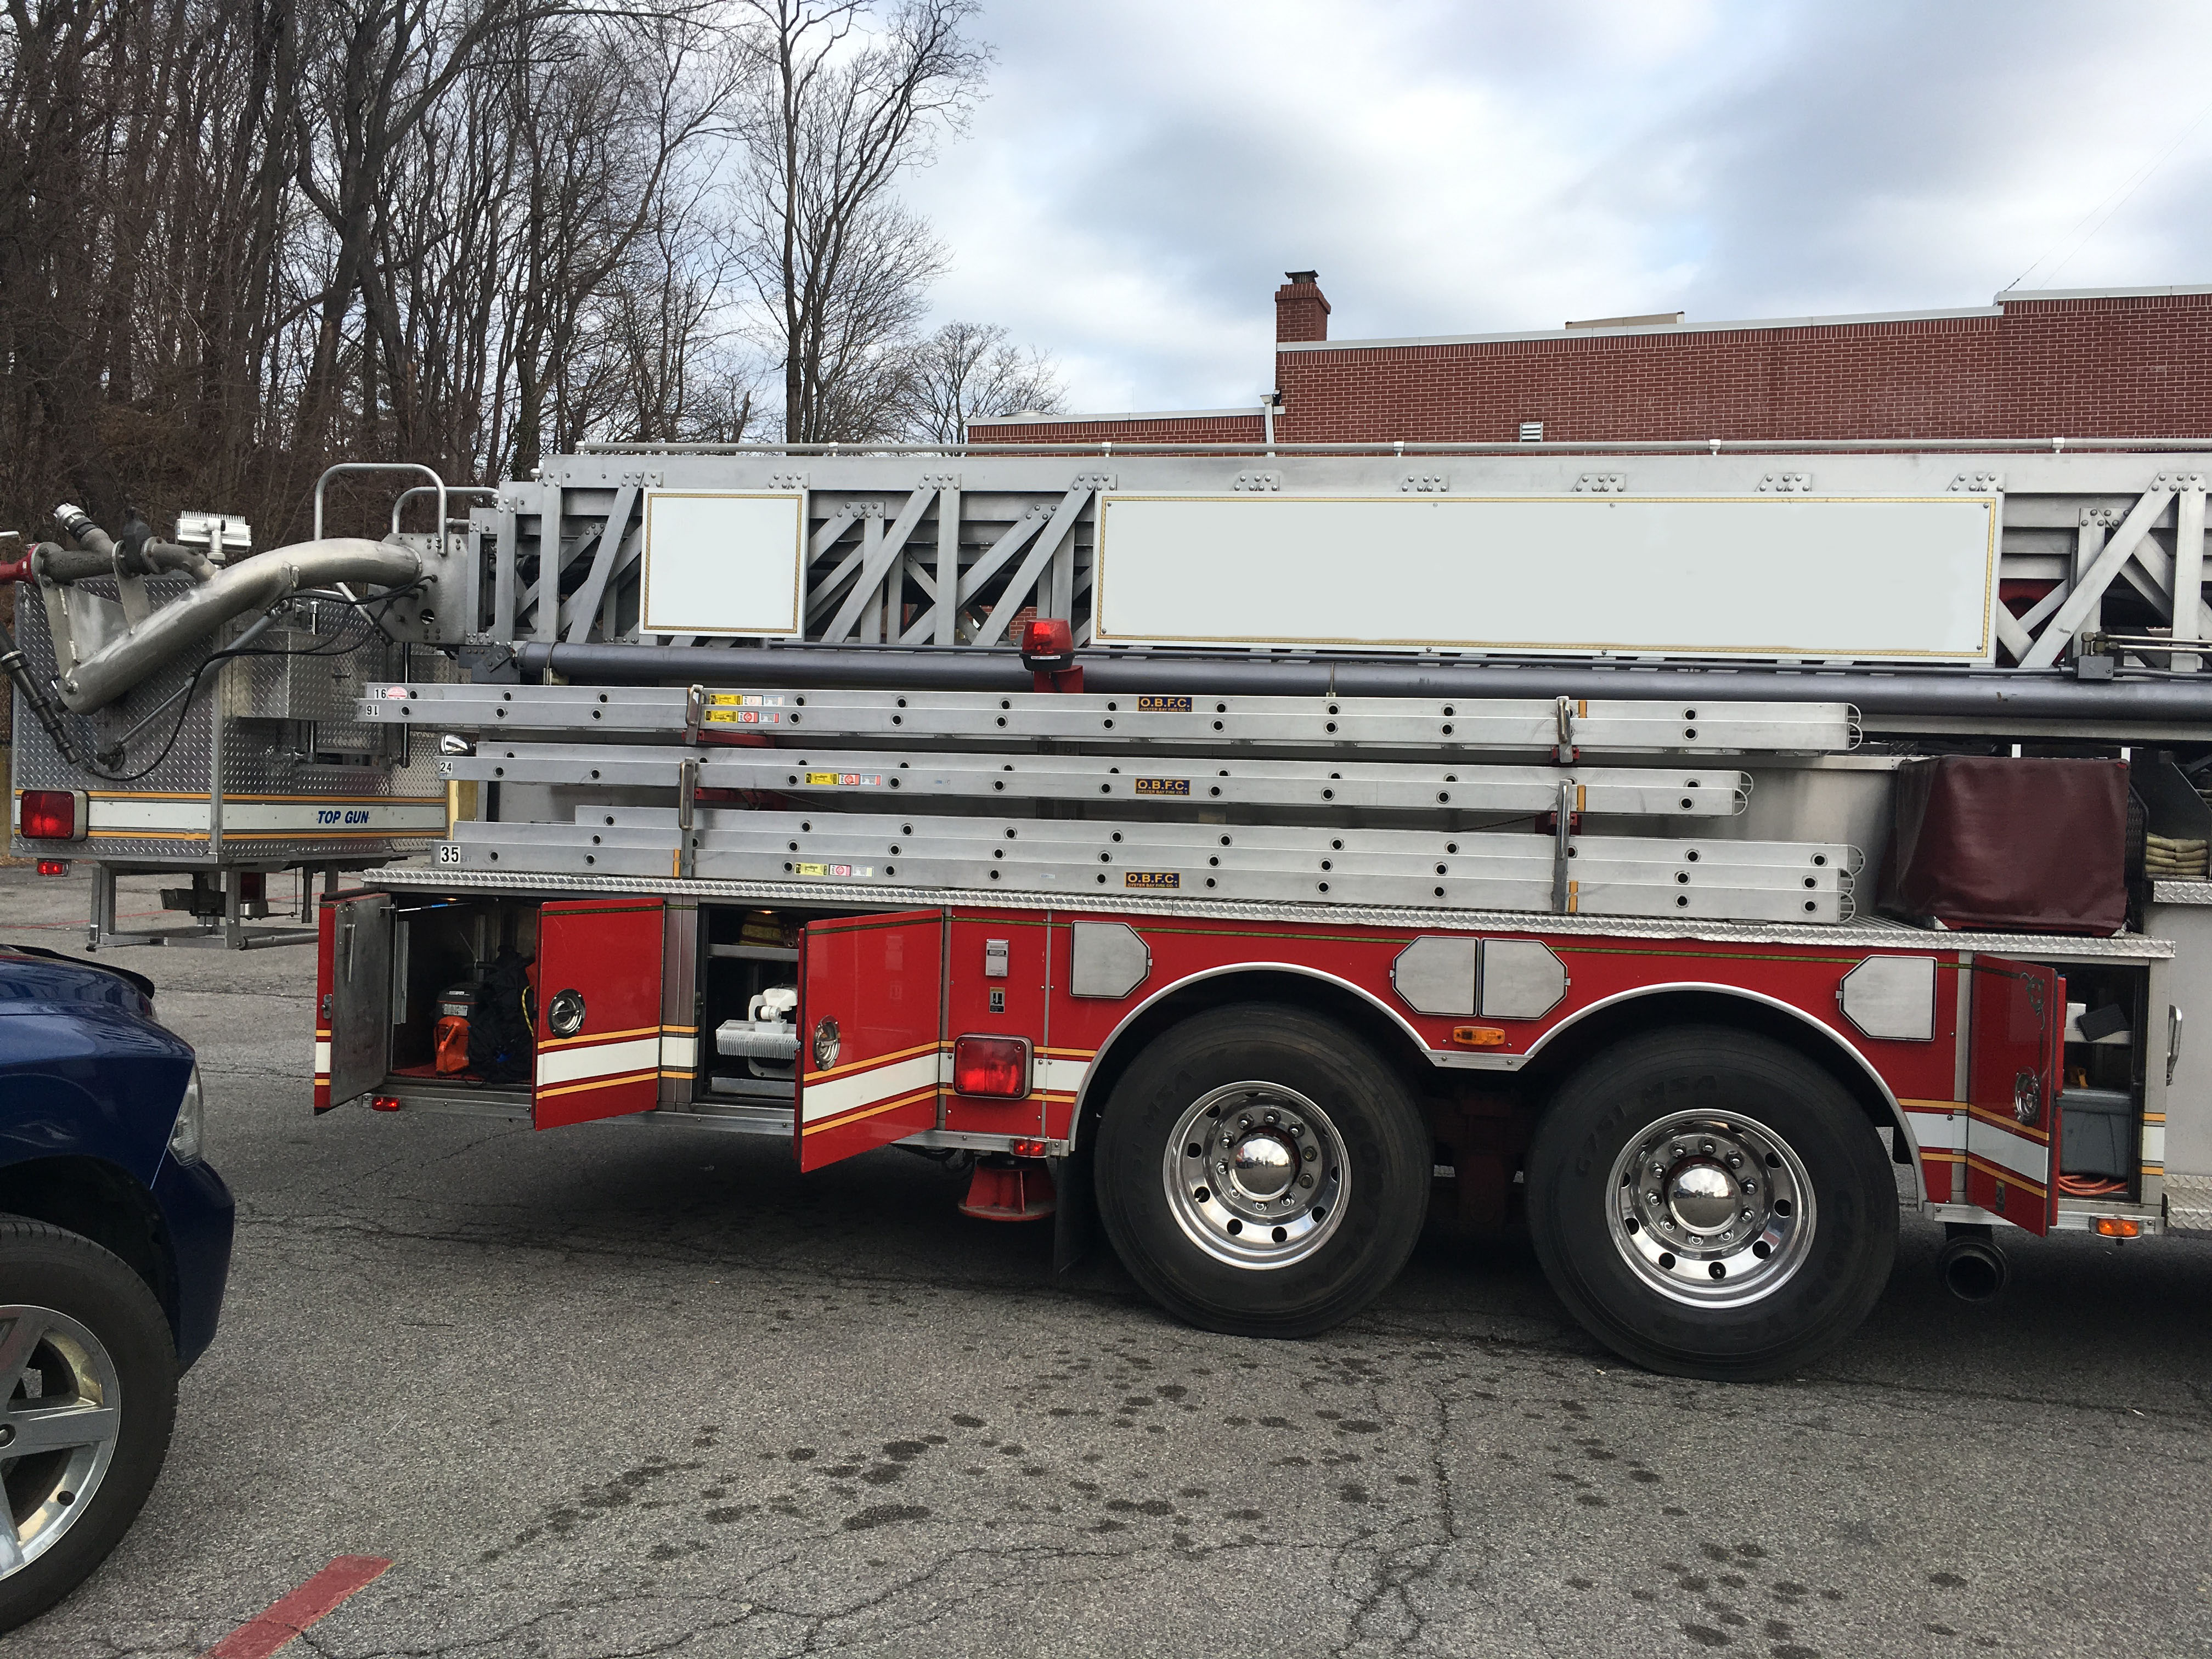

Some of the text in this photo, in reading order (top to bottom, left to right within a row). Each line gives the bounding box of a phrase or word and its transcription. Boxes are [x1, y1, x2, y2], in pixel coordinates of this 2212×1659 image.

[375, 689, 386, 699] 16
[1140, 698, 1190, 708] O.B.F.C.
[440, 762, 452, 772] 24
[1138, 780, 1188, 790] O.B.F.C.
[318, 810, 369, 824] TOP GUN
[441, 847, 459, 862] 35
[1127, 873, 1177, 883] O.B.F.C.
